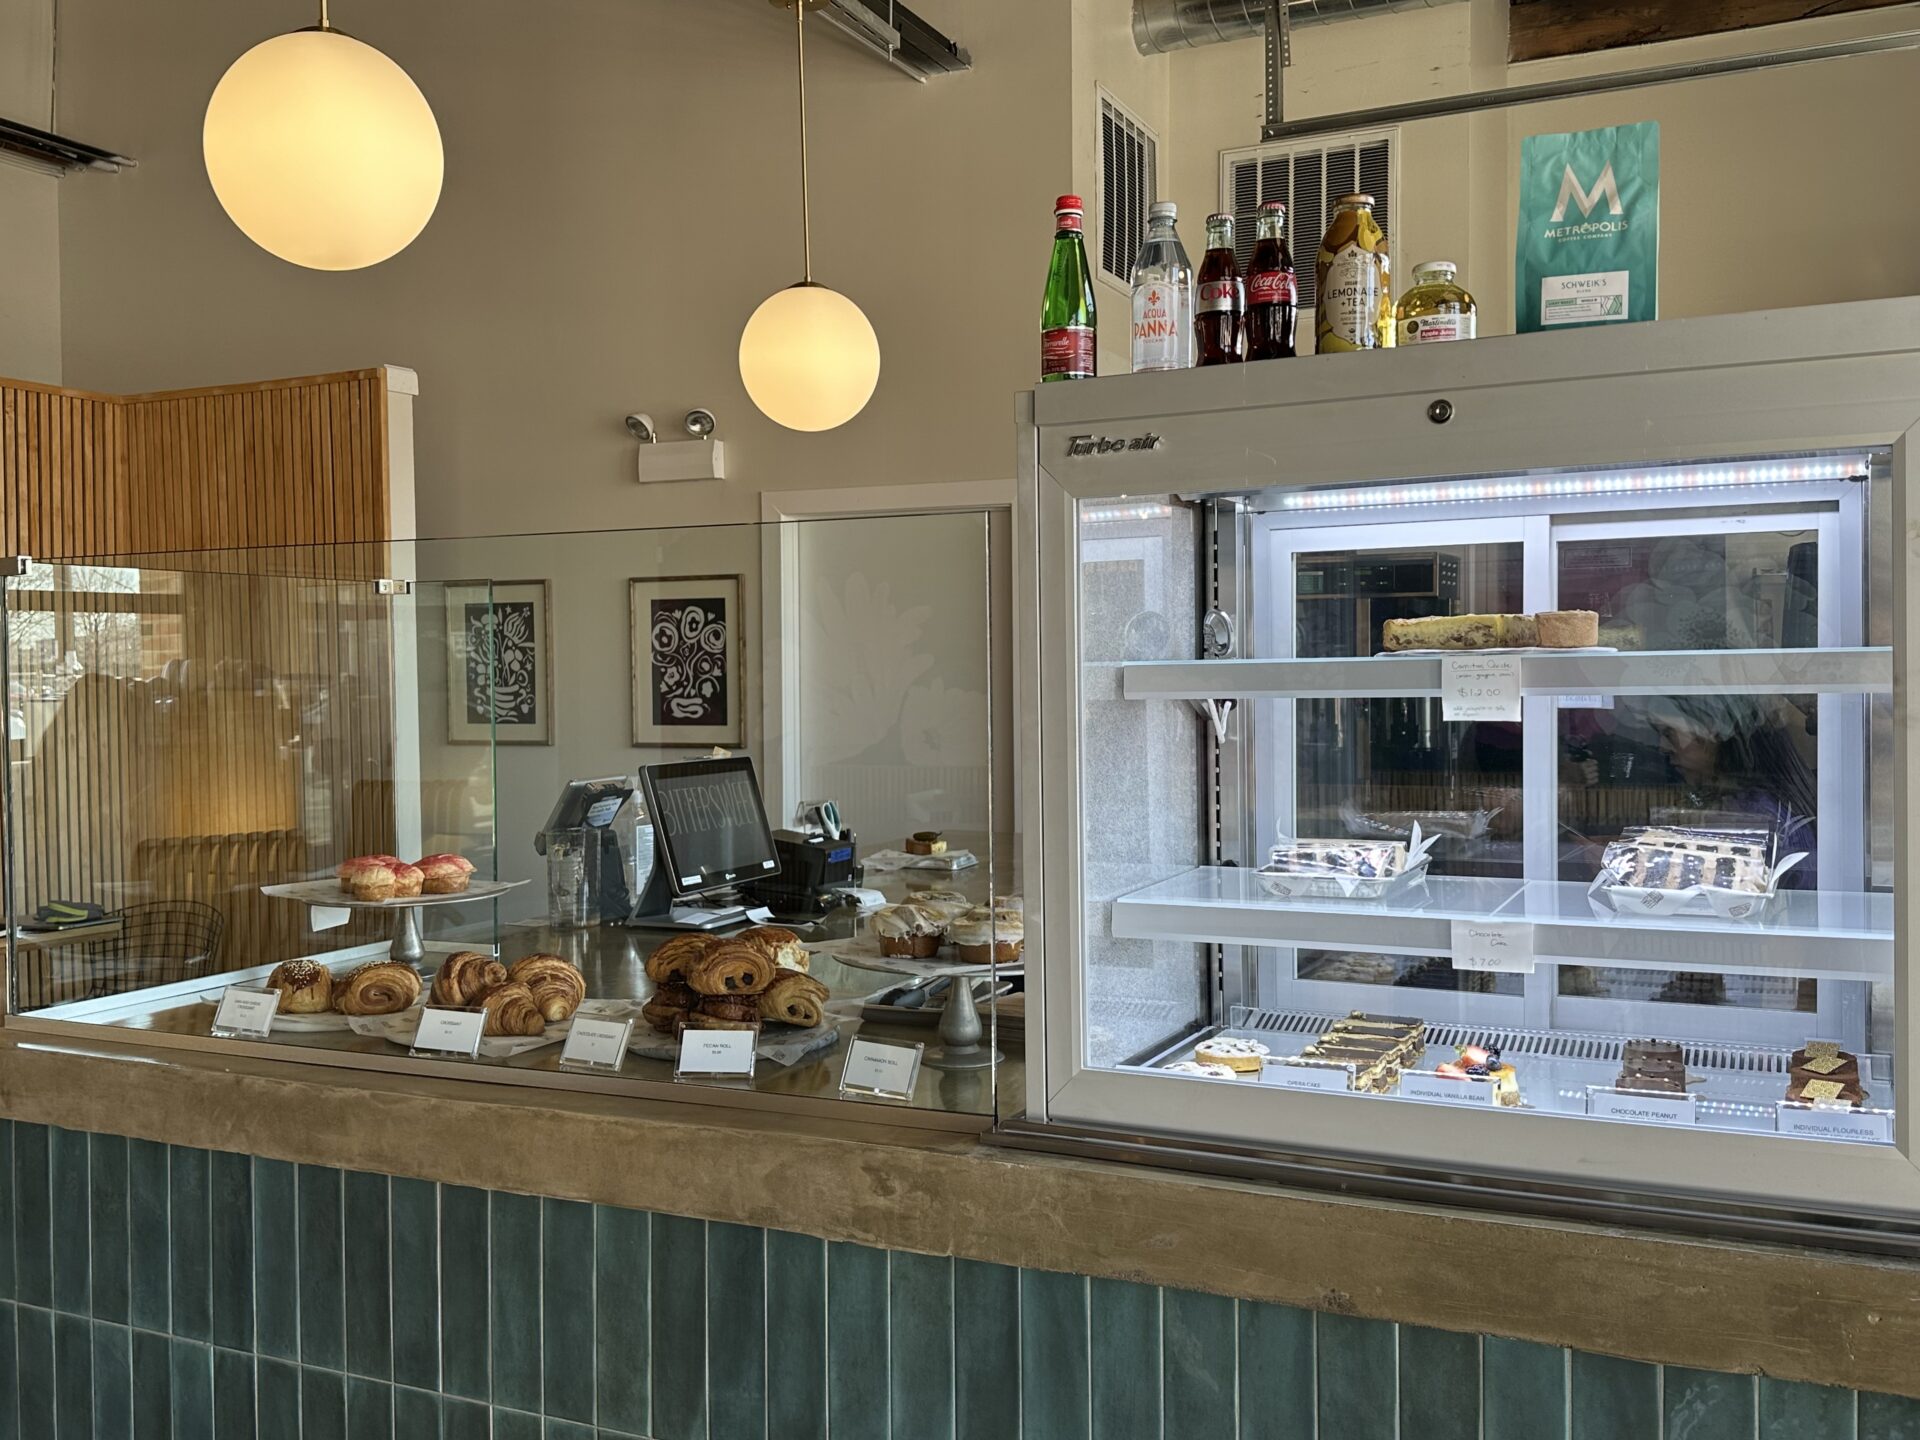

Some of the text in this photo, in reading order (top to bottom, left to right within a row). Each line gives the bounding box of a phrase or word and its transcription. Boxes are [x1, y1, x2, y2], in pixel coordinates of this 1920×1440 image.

[1544, 221, 1629, 239] METROPOLIS
[1558, 232, 1612, 243] COFFEE COMPANY
[1561, 279, 1608, 290] SCHWEIK'S
[1201, 283, 1240, 302] Coke
[1327, 287, 1379, 300] LEMONADE
[1143, 309, 1167, 319] ACQUA
[1134, 320, 1178, 339] PANNA
[1067, 432, 1161, 457] Turbo air
[658, 779, 759, 836] BITTERSWEET
[1410, 1089, 1442, 1098] INDIVIDUAL
[1611, 1107, 1649, 1116] CHOCOLATE
[1794, 1123, 1831, 1132] INDIVIDUAL
[1833, 1127, 1874, 1136] FLOURLESS
